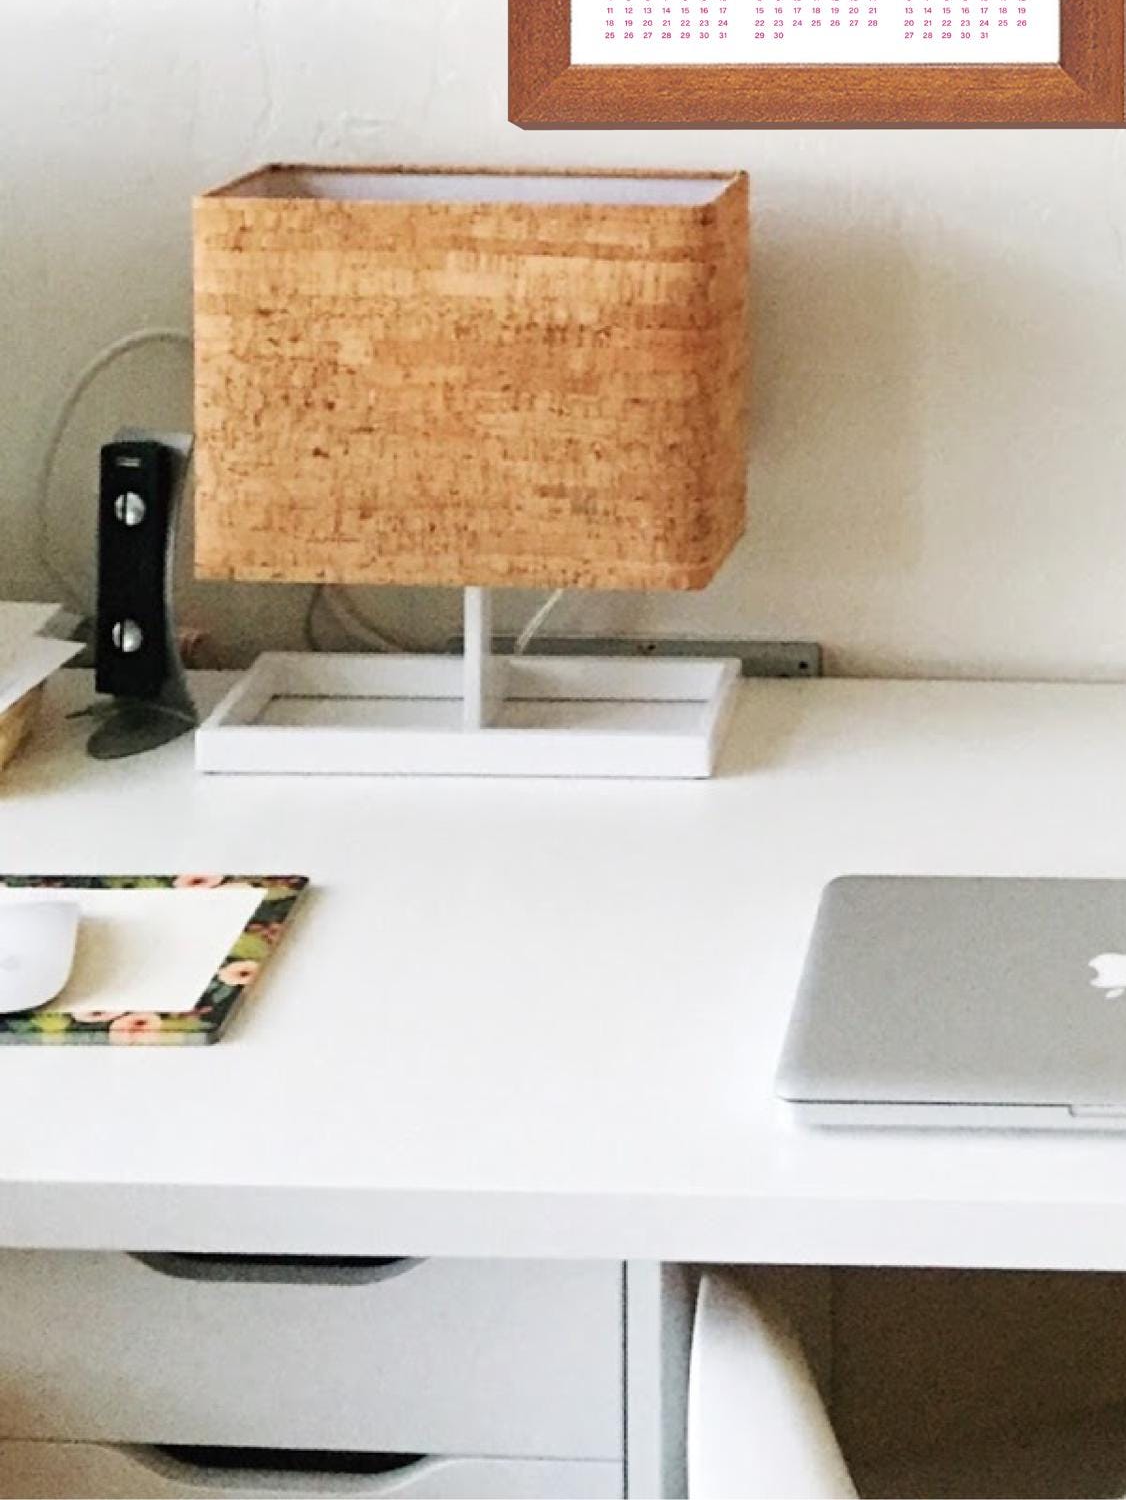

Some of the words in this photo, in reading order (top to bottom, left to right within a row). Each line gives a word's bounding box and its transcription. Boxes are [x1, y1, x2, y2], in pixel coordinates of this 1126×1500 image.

[754, 19, 765, 27] 22
[773, 19, 784, 27] 23
[792, 19, 803, 27] 24
[811, 19, 822, 27] 25
[830, 19, 841, 27] 26
[849, 19, 859, 27] 27
[867, 19, 878, 27] 28
[904, 19, 915, 27] 20
[923, 19, 932, 27] 21
[941, 19, 952, 27] 22
[960, 19, 971, 27] 23
[979, 19, 989, 27] 24
[998, 19, 1009, 27] 25
[1016, 19, 1027, 27] 26
[604, 31, 615, 39] 25
[623, 31, 634, 39] 26
[643, 31, 653, 39] 27
[661, 31, 672, 39] 28
[680, 31, 691, 39] 29
[699, 31, 710, 39] 30
[719, 31, 727, 39] 31
